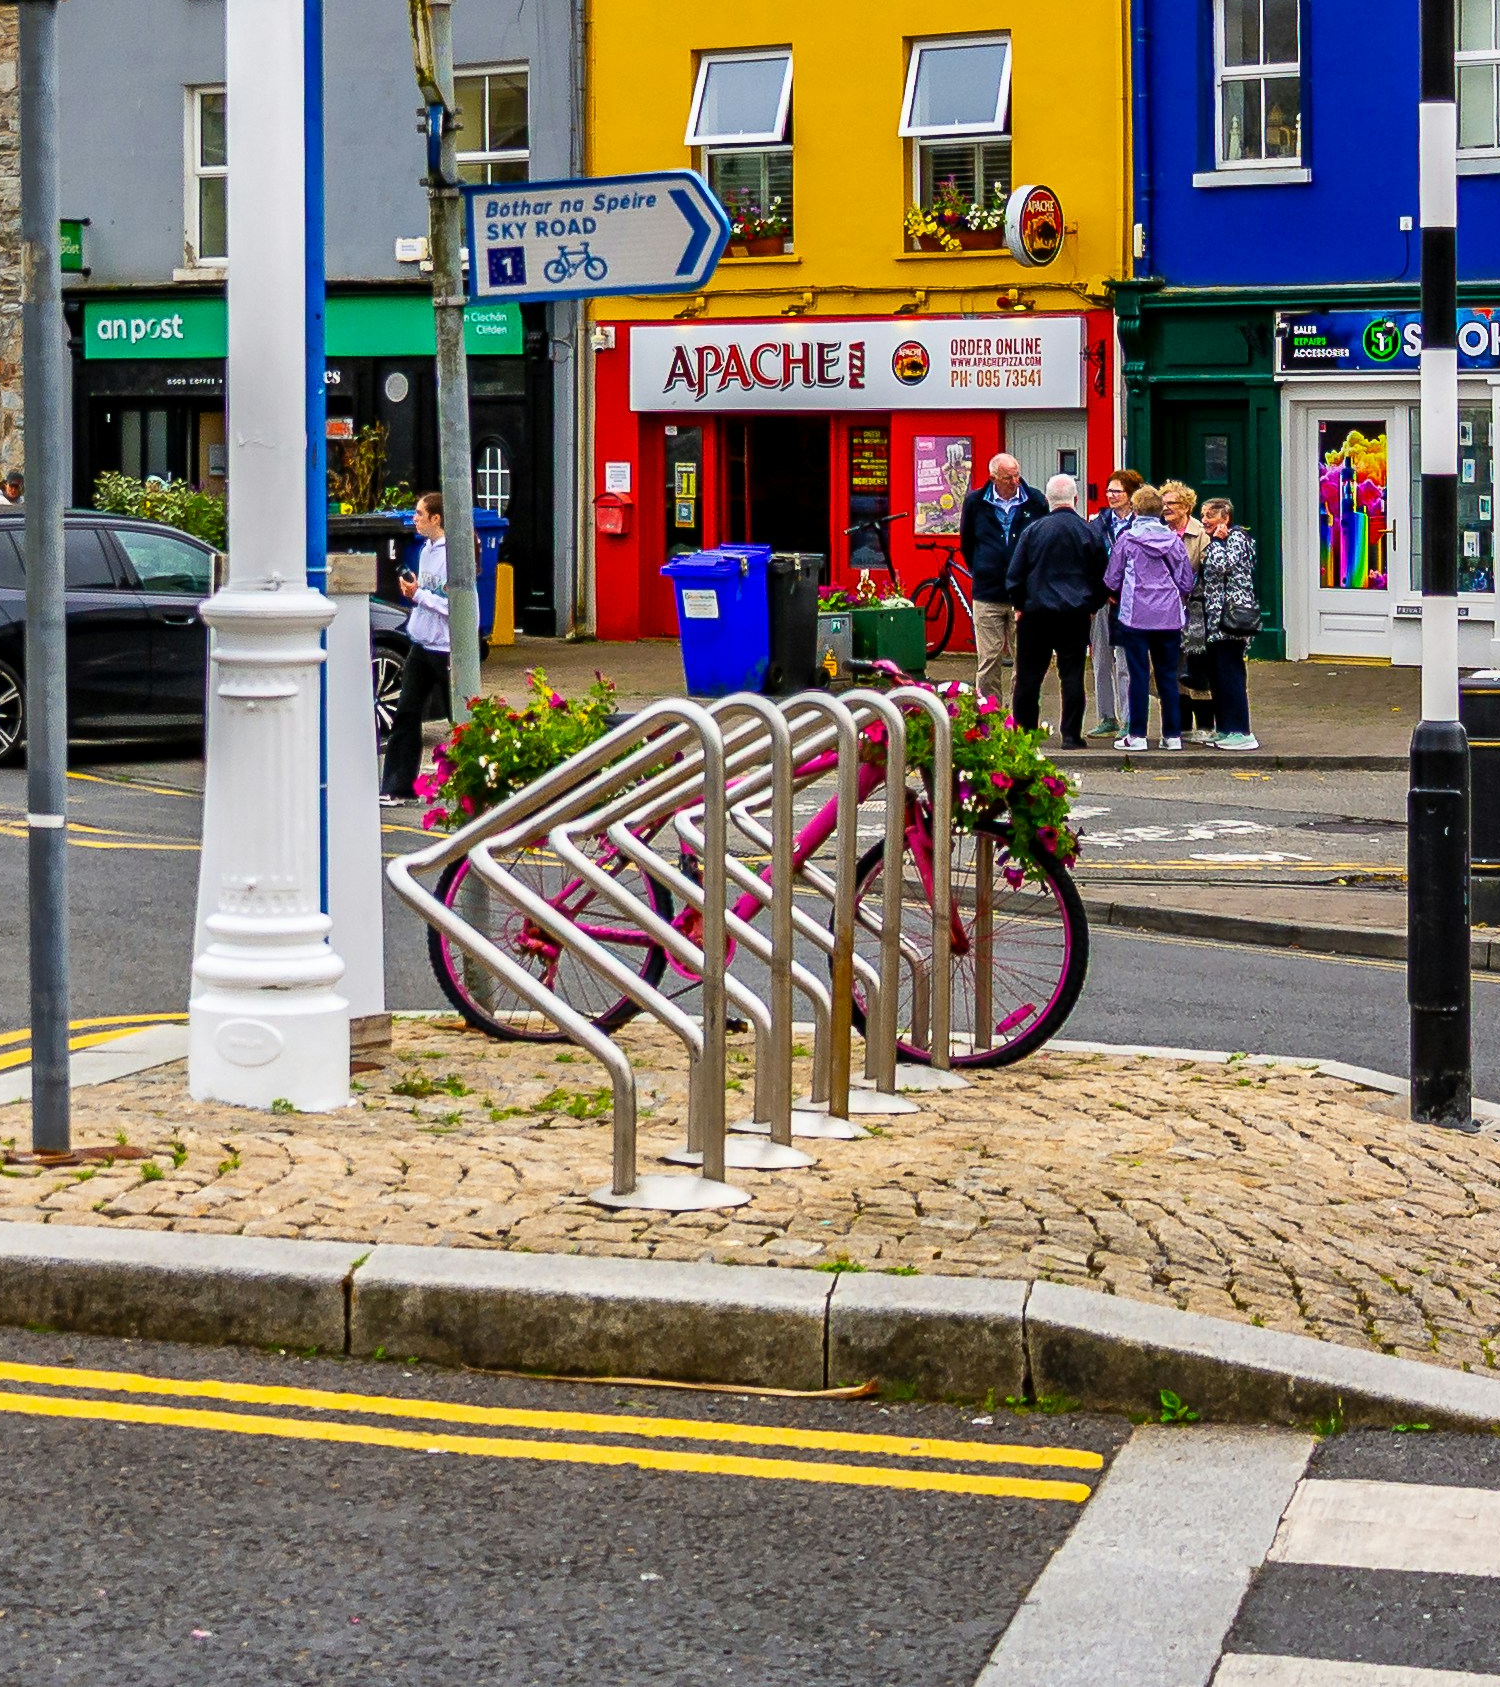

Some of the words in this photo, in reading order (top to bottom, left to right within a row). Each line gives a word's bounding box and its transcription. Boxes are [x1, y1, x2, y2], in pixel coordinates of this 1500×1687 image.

[560, 201, 584, 213] na
[593, 193, 657, 214] Spéire
[1027, 200, 1055, 213] APACHE
[486, 221, 528, 240] SKY
[536, 217, 597, 238] ROAD
[501, 257, 513, 277] 1
[97, 319, 127, 340] an
[131, 314, 183, 344] post
[476, 325, 507, 335] Clifden
[1294, 325, 1317, 334] SALES
[951, 339, 992, 355] ORDER
[996, 338, 1041, 355] ONLINE
[1294, 337, 1326, 346] REPAIRS
[951, 356, 1041, 367] WWW.APACHEPIZZA.COM
[1294, 348, 1350, 358] ACCESSORIES
[663, 341, 844, 402] APACHE
[849, 341, 865, 390] PIZZA
[951, 370, 972, 388] PH:
[976, 370, 1000, 387] 095
[1005, 369, 1041, 387] 73541
